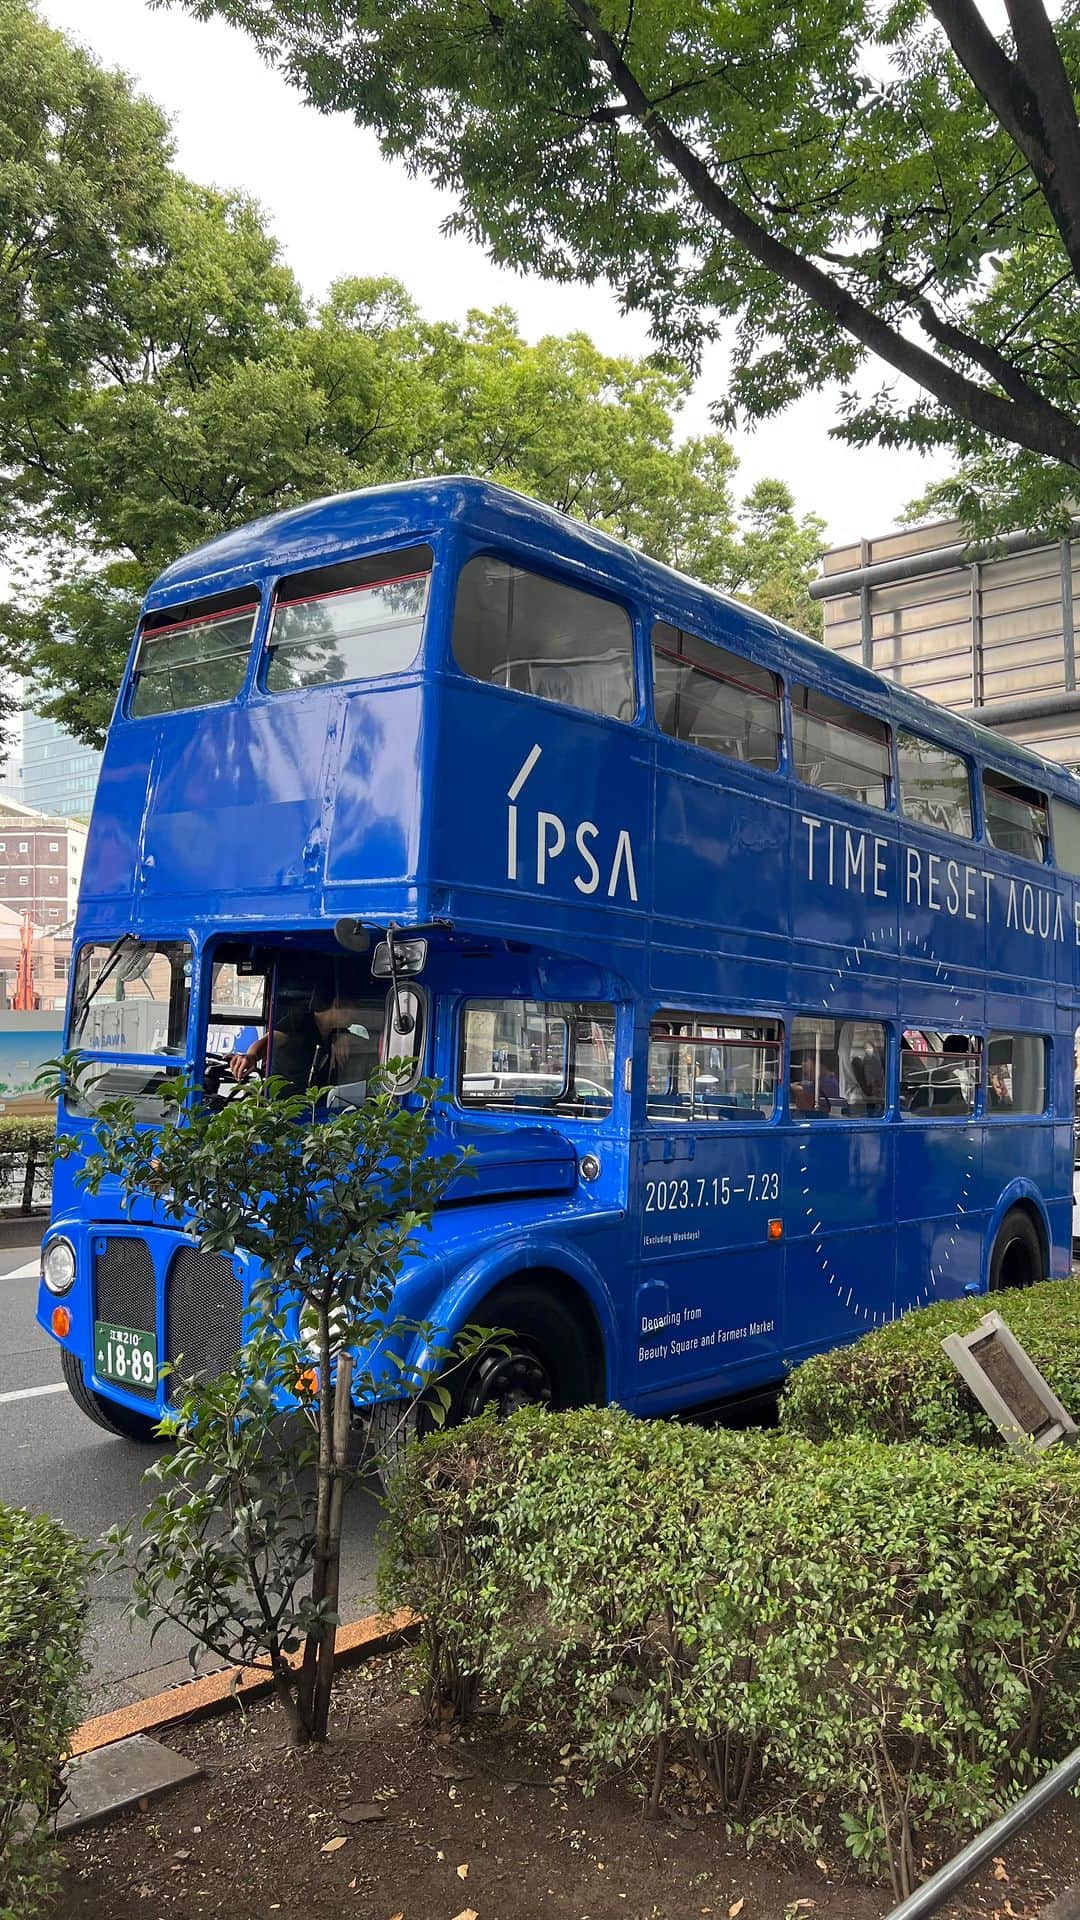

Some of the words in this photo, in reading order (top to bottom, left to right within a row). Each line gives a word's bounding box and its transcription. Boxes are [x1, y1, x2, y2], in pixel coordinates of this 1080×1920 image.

[802, 817, 888, 898] TIME
[906, 848, 995, 923] RESET
[1006, 880, 1065, 943] AQUA
[643, 1233, 672, 1246] (Excluding
[673, 1230, 700, 1242] Weekdays)
[641, 1311, 681, 1331] Departing
[684, 1307, 702, 1321] from
[639, 1345, 668, 1362] Beauty
[670, 1338, 698, 1355] Square
[701, 1331, 715, 1346] and
[717, 1328, 747, 1343] Farmers
[749, 1320, 774, 1336] Market
[107, 1342, 154, 1384] 18-89
